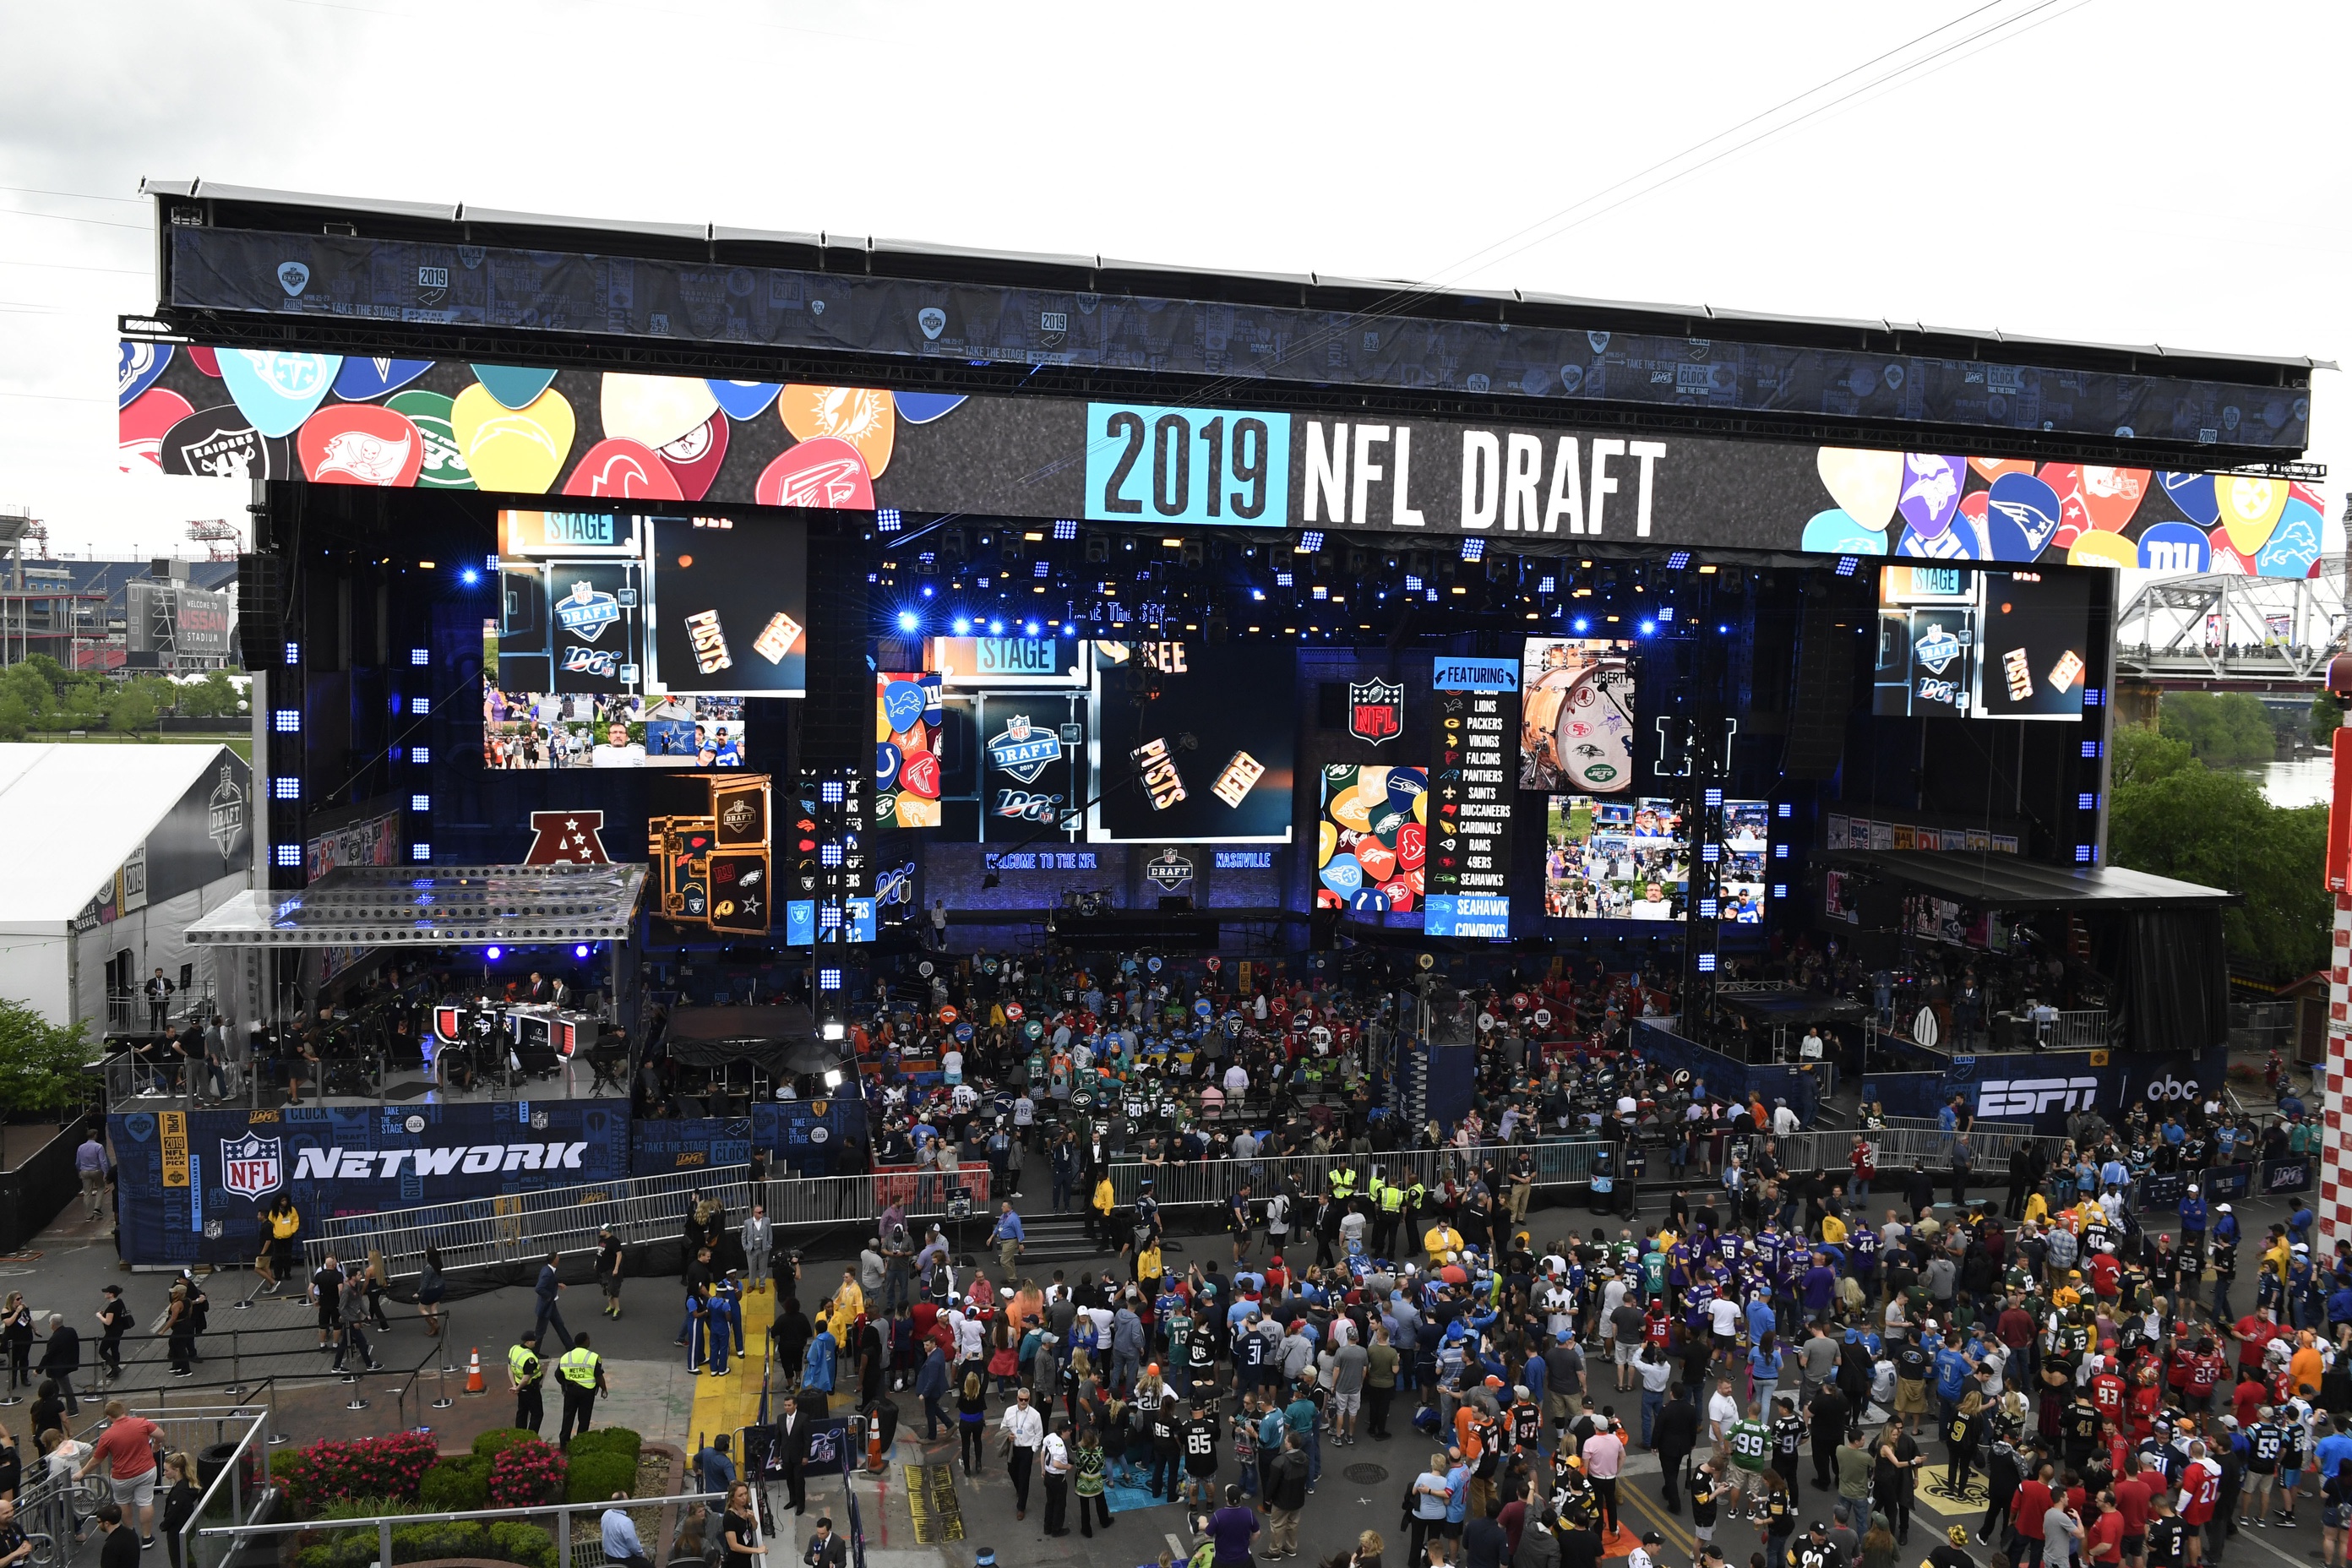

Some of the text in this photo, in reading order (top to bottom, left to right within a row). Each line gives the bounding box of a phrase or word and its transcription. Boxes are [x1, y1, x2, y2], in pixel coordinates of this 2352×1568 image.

[421, 269, 446, 286] 2019
[680, 273, 726, 284] DRAFT
[514, 279, 542, 291] STAGE
[774, 282, 799, 300] 2019
[286, 298, 302, 309] 2019
[332, 302, 400, 318] TAKE THE STAGE
[496, 300, 519, 308] THE
[650, 313, 668, 324] APRIL
[1043, 315, 1065, 330] 2019
[1235, 319, 1254, 329] THE
[650, 324, 669, 333] 25-27
[1364, 331, 1379, 340] APRIL
[924, 341, 939, 352] 2019
[1363, 340, 1380, 350] 25-27
[965, 346, 1025, 359] TAKE THE STAGE
[1626, 358, 1676, 372] TAKE THE STAGE
[1680, 370, 1708, 384] CLOCK
[1990, 372, 2015, 384] CLOCK
[2200, 429, 2217, 442] 2019
[193, 433, 255, 458] RAIDERS
[1104, 411, 1667, 537] 2019 NFL DRAFT
[550, 512, 609, 542] STAGE
[1915, 568, 1955, 591] STAGE
[575, 590, 591, 603] NFL
[186, 600, 210, 609] WELCOME
[177, 608, 226, 631] NISSAN
[561, 604, 612, 624] DRAFT
[187, 632, 219, 643] STADIUM
[686, 609, 733, 674] POSTS
[983, 638, 1052, 670] STAGE
[1919, 643, 1957, 662] DRAFT
[1447, 667, 1505, 684] FEATURING
[1592, 672, 1630, 684] LIBERTY
[2003, 647, 2034, 702] POSTS
[1474, 700, 1497, 713] LIONS
[1355, 704, 1397, 736] NFL
[1467, 716, 1503, 731] PACKERS
[1011, 726, 1030, 740] NFL
[1468, 734, 1500, 748] VIKINGS
[994, 740, 1056, 763] DRAFT
[1466, 751, 1501, 765] FALCONS
[1019, 764, 1035, 772] 2019
[1211, 749, 1266, 809] HERE!
[1462, 769, 1503, 782] PANTHERS
[1467, 787, 1496, 799] SAINTS
[211, 804, 241, 830] DRAFT
[727, 813, 754, 822] DRAFT
[1039, 810, 1054, 823] NFL
[1460, 803, 1511, 818] BUCCANEERS
[1459, 821, 1502, 835] CARDINALS
[1851, 826, 1868, 839] BIG
[1468, 838, 1491, 852] RAMS
[1894, 832, 1914, 846] HAIL
[986, 852, 1097, 870] WELCOME TO THE NFL
[1215, 852, 1271, 868] NASHVILLE
[1467, 856, 1492, 868] 49ERS
[127, 864, 143, 895] 2019
[1151, 868, 1190, 878] DRAFT
[1460, 873, 1504, 886] SEAHAWKS
[1455, 923, 1506, 938] COWBOYS
[1110, 1004, 1119, 1014] 31
[1029, 1066, 1043, 1078] 13
[2147, 1074, 2199, 1102] abc
[958, 1094, 969, 1105] 12
[1978, 1076, 2098, 1117] ESPN
[291, 1108, 329, 1120] CLOCK
[383, 1106, 400, 1116] TAKE
[1128, 1103, 1142, 1118] 80
[1160, 1102, 1175, 1118] 28
[166, 1113, 178, 1135] APRIL
[380, 1116, 390, 1124] THE
[531, 1117, 548, 1126] NFL
[791, 1118, 806, 1127] TAKE
[1866, 1118, 1881, 1130] 92
[380, 1124, 404, 1135] STAGE
[787, 1127, 798, 1135] THE
[165, 1137, 185, 1149] 2019
[788, 1135, 809, 1145] STAGE
[2219, 1133, 2234, 1142] 59
[644, 1141, 709, 1152] TAKE THE STAGE
[716, 1146, 750, 1162] CLOCK
[2131, 1151, 2145, 1163] 59
[229, 1141, 590, 1190] NFL NETWORK
[404, 1172, 420, 1198] 2019
[503, 1183, 520, 1192] 2019
[209, 1187, 226, 1198] APRIL
[208, 1197, 230, 1206] 25-27
[205, 1226, 222, 1236] NFL
[2072, 1221, 2079, 1234] 6
[1859, 1241, 1875, 1253] 44
[2087, 1233, 2105, 1250] 40
[1722, 1246, 1736, 1260] 19
[1649, 1265, 1662, 1279] 14
[2179, 1259, 2197, 1273] 52
[1622, 1274, 1638, 1289] 26
[2023, 1275, 2034, 1292] 12
[1697, 1297, 1712, 1315] 28
[1652, 1324, 1666, 1336] 16
[1173, 1330, 1187, 1345] 13
[2073, 1336, 2087, 1351] 12
[1248, 1345, 1262, 1365] 31
[1888, 1371, 1896, 1387] 9
[1943, 1364, 1952, 1383] 9
[2101, 1380, 2116, 1388] McCOY
[1141, 1396, 1160, 1409] 20
[2098, 1386, 2119, 1406] 93
[1154, 1422, 1170, 1438] 85
[1520, 1421, 1537, 1439] 97
[1744, 1423, 1761, 1432] BROWN
[1951, 1419, 1967, 1442] 9
[2076, 1419, 2093, 1437] 41
[1187, 1433, 1211, 1454] 85
[1487, 1434, 1499, 1452] 14
[1736, 1432, 1764, 1456] 99
[2257, 1437, 2280, 1459] 59
[820, 1450, 834, 1462] NFL
[2199, 1477, 2220, 1504] 27
[2171, 1536, 2181, 1556] 2
